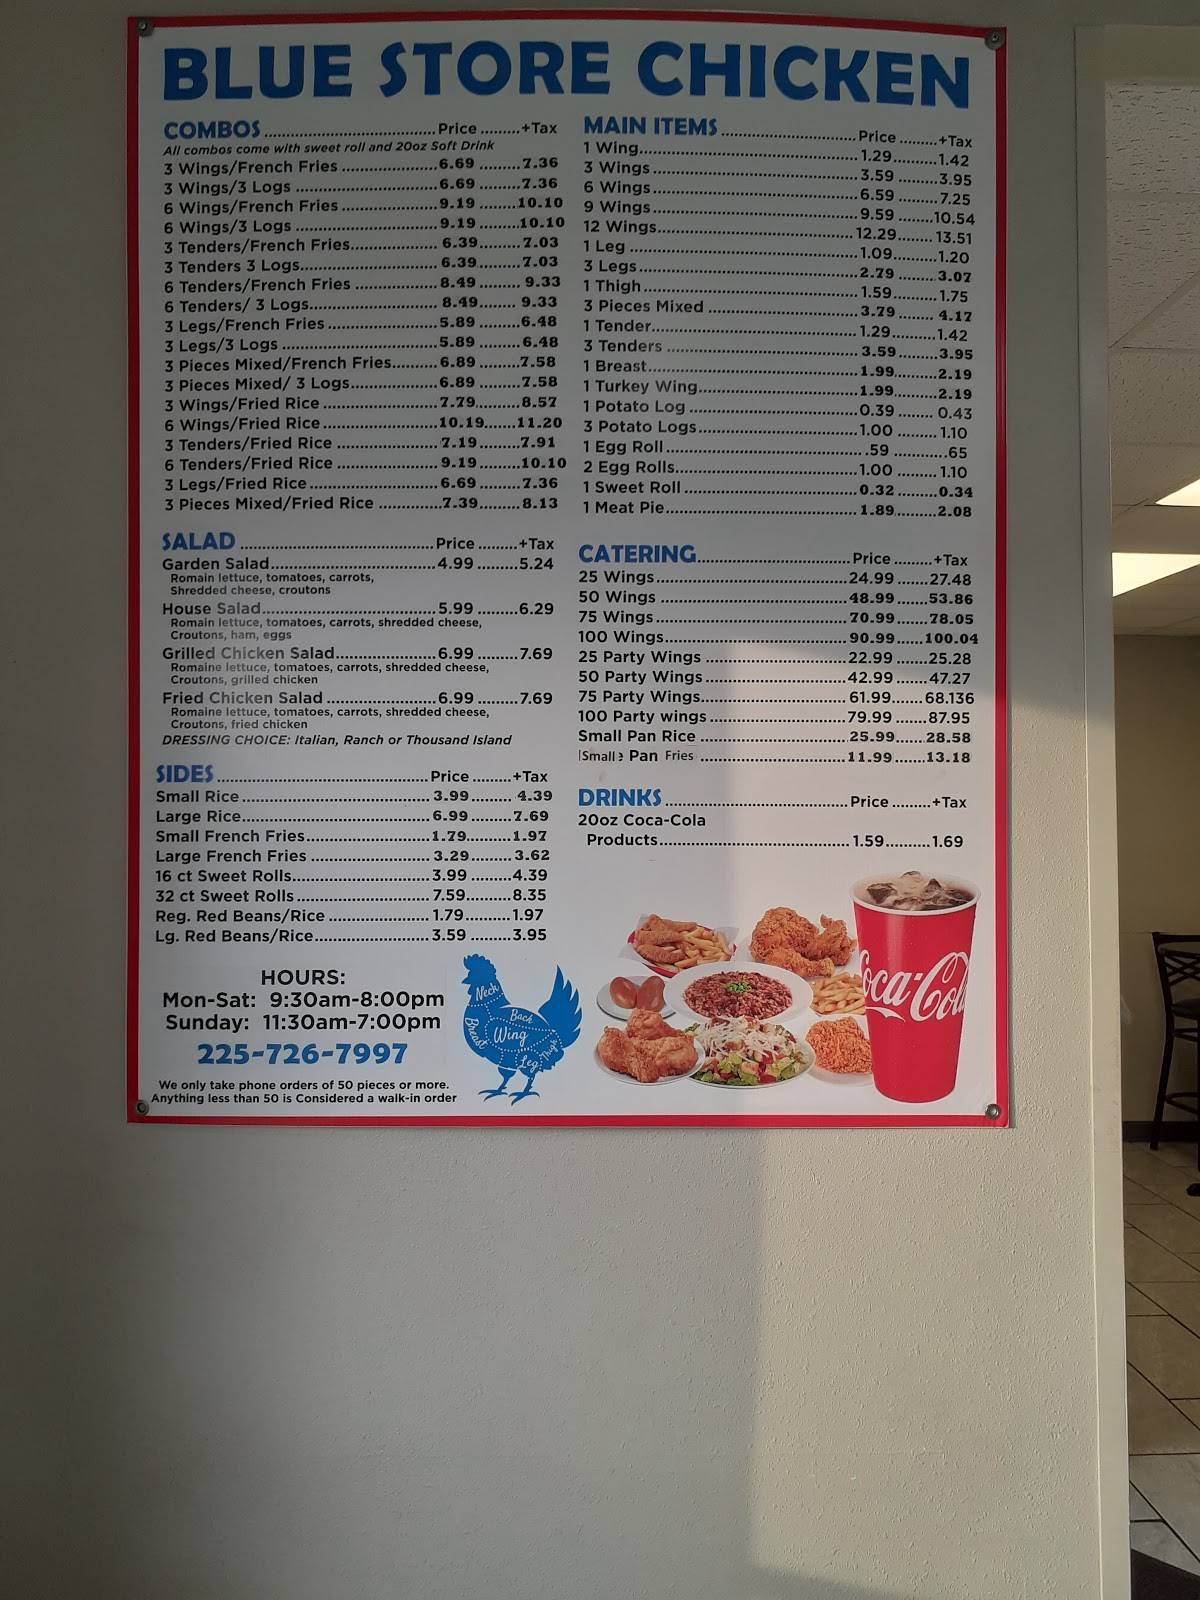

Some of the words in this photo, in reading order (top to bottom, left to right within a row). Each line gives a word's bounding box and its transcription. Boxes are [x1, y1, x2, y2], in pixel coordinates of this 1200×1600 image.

[163, 44, 353, 101] BLUE
[379, 40, 611, 98] STORE
[637, 40, 970, 109] CHICKEN
[164, 119, 261, 140] COMBOS
[438, 121, 477, 135] Price
[521, 120, 558, 135] +Tax
[584, 115, 646, 135] MAIN
[654, 116, 718, 137] ITEMS
[859, 130, 896, 144] Price
[938, 134, 973, 148] +Tax
[162, 144, 181, 156] All
[183, 143, 233, 157] combos
[236, 144, 270, 156] come
[274, 142, 301, 154] with
[304, 143, 341, 154] sweet
[344, 141, 366, 153] roll
[368, 141, 393, 152] and
[395, 141, 428, 153] 20oz
[430, 140, 458, 152] Soft
[460, 138, 495, 152] Drink
[583, 141, 590, 154] 1
[595, 140, 639, 157] Wing
[861, 148, 892, 163] 1.29
[938, 153, 969, 168] 1.42
[164, 163, 173, 176] 3
[178, 159, 293, 177] Wings/French
[299, 159, 338, 173] Fries
[439, 157, 475, 170] 6.69
[522, 157, 558, 169] 7.36
[164, 182, 173, 195] 3
[178, 179, 247, 197] Wings/3
[252, 180, 291, 196] Logs
[439, 177, 475, 190] 6.69
[521, 177, 558, 190] 7.36
[583, 219, 600, 233] 12
[605, 219, 657, 236] Wings
[856, 226, 897, 241] 12.29
[936, 230, 972, 245] 13.51
[164, 240, 173, 255] 3
[178, 238, 305, 255] Tenders/French
[311, 237, 350, 251] Fries
[442, 236, 478, 249] 6.39
[522, 236, 559, 248] 7.03
[584, 299, 593, 312] 3
[599, 299, 651, 312] Pieces
[656, 299, 704, 313] Mixed
[860, 305, 896, 318] 3.79
[938, 309, 972, 323] 4.17
[164, 320, 174, 333] 3
[179, 316, 280, 335] Legs/French
[285, 316, 325, 331] Fries
[440, 316, 475, 328] 5.89
[521, 315, 557, 328] 6.48
[164, 360, 174, 373] 3
[179, 358, 230, 373] Pieces
[235, 355, 347, 373] Mixed/French
[352, 355, 392, 369] Fries
[440, 355, 476, 368] 6.89
[520, 356, 556, 368] 7.58
[164, 419, 174, 432] 6
[179, 415, 280, 433] Wings/Fried
[286, 416, 320, 430] Rice
[439, 416, 485, 429] 10.19
[517, 416, 563, 429] 11.20
[583, 500, 589, 514] 1
[595, 500, 634, 514] Meat
[640, 500, 664, 514] Pie
[860, 504, 895, 516] 1.89
[937, 505, 972, 518] 2.08
[162, 531, 236, 552] SALAD
[436, 536, 475, 550] Price
[518, 537, 554, 550] +Tax
[162, 557, 220, 571] Garden
[225, 556, 269, 570] Salad
[437, 556, 474, 570] 4.99
[519, 557, 554, 570] 5.24
[578, 544, 697, 563] CATERING
[853, 552, 891, 565] Price
[933, 553, 968, 566] +Tax
[170, 571, 215, 583] Romain
[218, 572, 264, 584] lettuce,
[266, 572, 330, 584] tomatoes,
[329, 571, 374, 584] carrots,
[170, 584, 227, 596] Shredded
[230, 585, 275, 596] cheese,
[278, 585, 331, 596] croutons
[578, 630, 608, 643] 100
[613, 629, 664, 646] Wings
[849, 632, 895, 645] 90.99
[925, 632, 979, 645] 100.04
[163, 691, 204, 705] Fried
[209, 691, 273, 704] Chicken
[279, 691, 323, 704] Salad
[438, 690, 474, 705] 6.99
[520, 692, 553, 705] 7.69
[161, 734, 231, 745] DRESSING
[235, 735, 291, 745] CHOICE:
[294, 734, 339, 747] Italian,
[343, 734, 384, 745] Ranch
[388, 736, 403, 745] or
[406, 734, 470, 745] Thousand
[472, 734, 513, 746] Island
[156, 764, 214, 783] SIDES
[431, 770, 470, 783] Price
[513, 769, 548, 783] +Tax
[155, 790, 199, 803] Small
[205, 789, 239, 803] Rice
[433, 790, 469, 802] 3.99
[517, 790, 553, 802] 4.39
[578, 788, 662, 807] DRINKS
[851, 795, 889, 808] Price
[932, 796, 967, 808] +Tax
[577, 813, 618, 827] 20oz
[623, 813, 706, 827] Coca-Cola
[587, 833, 658, 846] Products
[853, 834, 884, 848] 1.59
[932, 835, 964, 848] 1.69
[156, 850, 201, 865] Large
[207, 849, 262, 863] French
[267, 849, 307, 862] Fries
[433, 850, 469, 862] 3.29
[514, 849, 550, 861] 3.62
[155, 909, 191, 925] Reg.
[196, 909, 228, 923] Red
[233, 908, 325, 924] Beans/Rice
[432, 908, 464, 921] 1.79
[512, 908, 544, 921] 1.97
[261, 969, 345, 986] HOURS:
[163, 991, 256, 1008] Mon-Sat:
[270, 991, 444, 1010] 9:30am-8:00pm
[475, 983, 500, 1001] Neck
[165, 1013, 249, 1034] Sunday:
[263, 1013, 441, 1033] 11:30am-7:00pm
[509, 1009, 534, 1024] Back
[464, 1017, 489, 1050] Breast
[494, 1026, 528, 1047] Wing
[197, 1042, 408, 1065] 225-726-7997
[517, 1055, 540, 1073] Leg
[158, 1080, 178, 1090] We
[181, 1080, 207, 1092] only
[209, 1080, 235, 1092] take
[238, 1080, 276, 1092] phone
[279, 1080, 318, 1092] orders
[321, 1080, 335, 1090] of
[337, 1080, 354, 1090] 50
[357, 1079, 396, 1092] pieces
[399, 1081, 412, 1090] or
[415, 1080, 449, 1090] more.
